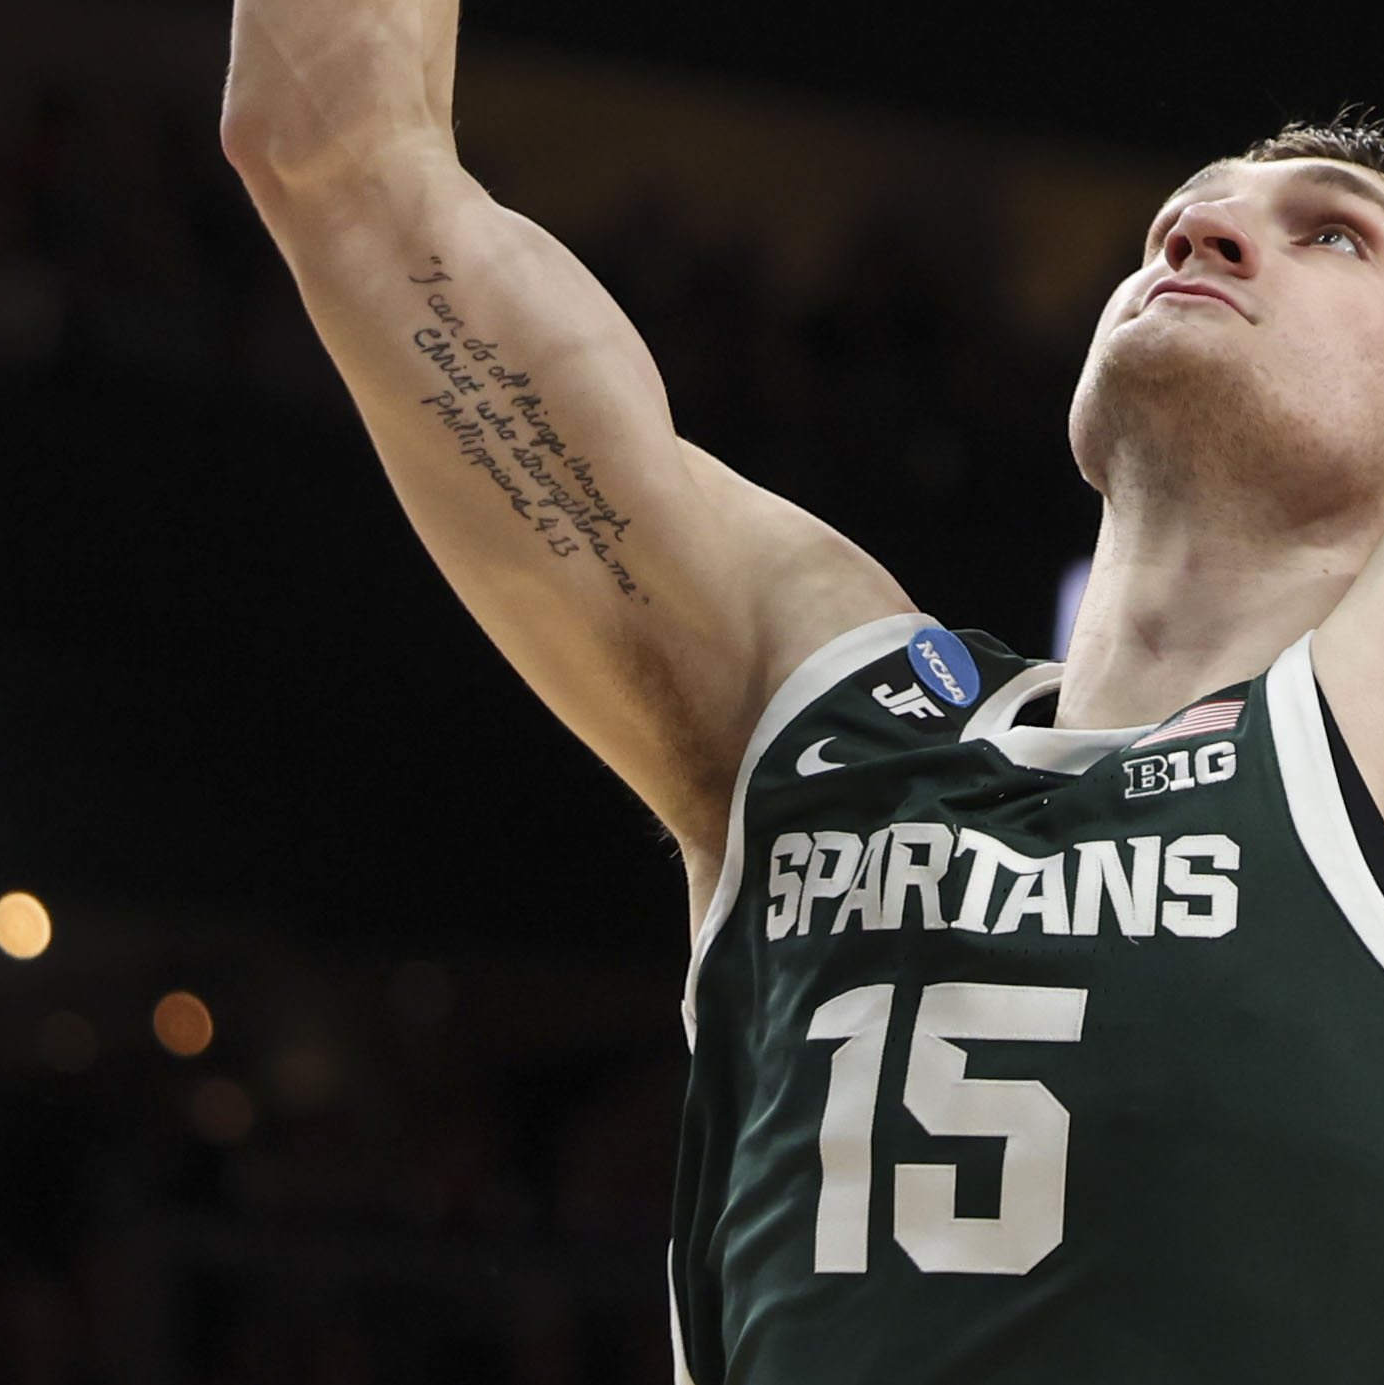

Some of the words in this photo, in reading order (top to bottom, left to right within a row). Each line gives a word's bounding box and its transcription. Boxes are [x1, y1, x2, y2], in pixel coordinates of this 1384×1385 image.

[414, 328, 485, 395] Christ
[476, 400, 518, 440] who
[512, 447, 610, 562] strengthens
[428, 294, 464, 338] can
[463, 339, 498, 361] do
[488, 366, 531, 389] all
[511, 394, 567, 457] things
[564, 455, 631, 542] through
[871, 682, 946, 719] JF
[915, 639, 967, 703] NCAA
[766, 822, 1241, 943] SPARTANS
[805, 982, 1089, 1276] 15
